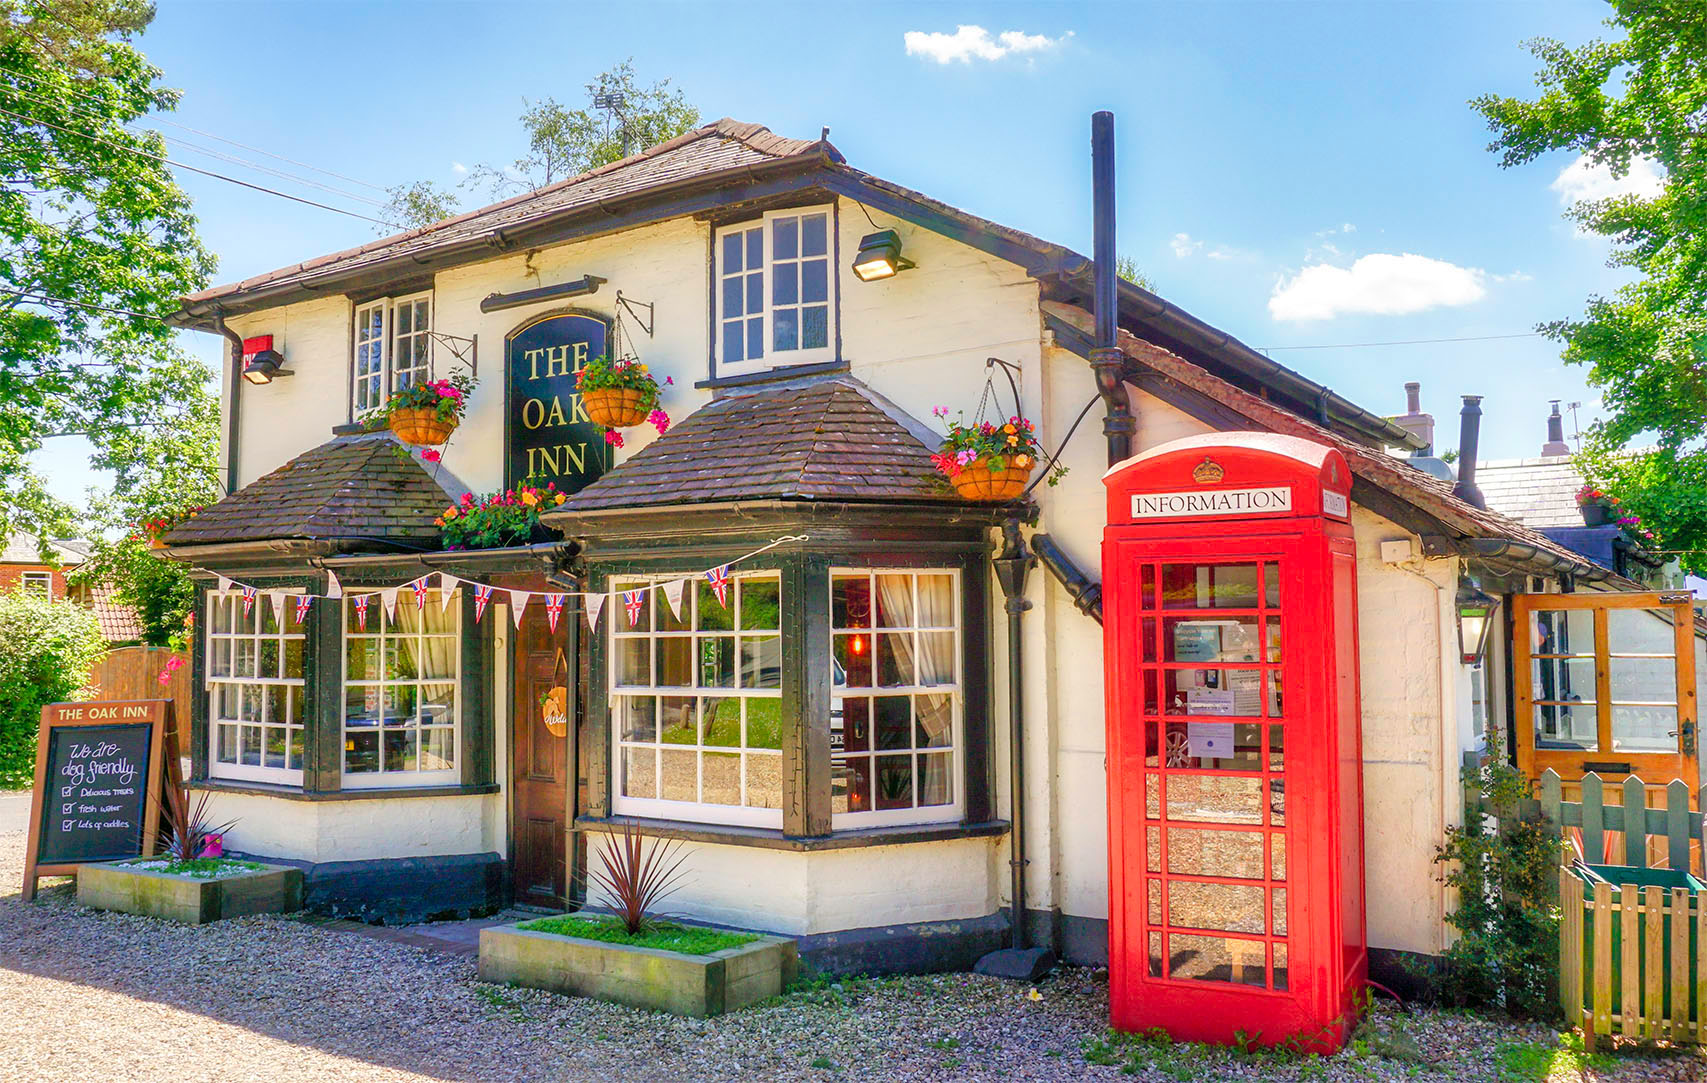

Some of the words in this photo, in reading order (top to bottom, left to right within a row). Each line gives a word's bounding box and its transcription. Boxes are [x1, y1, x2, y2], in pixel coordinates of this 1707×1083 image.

[524, 341, 589, 381] THE
[522, 393, 591, 430] OAK
[526, 442, 588, 479] INN
[1136, 490, 1287, 514] INFORMATION
[58, 708, 83, 720] THE
[88, 707, 118, 719] OAK
[122, 706, 148, 718] INN
[69, 743, 91, 759] We
[91, 741, 121, 758] are
[61, 759, 85, 786] dog
[86, 757, 138, 785] friendly
